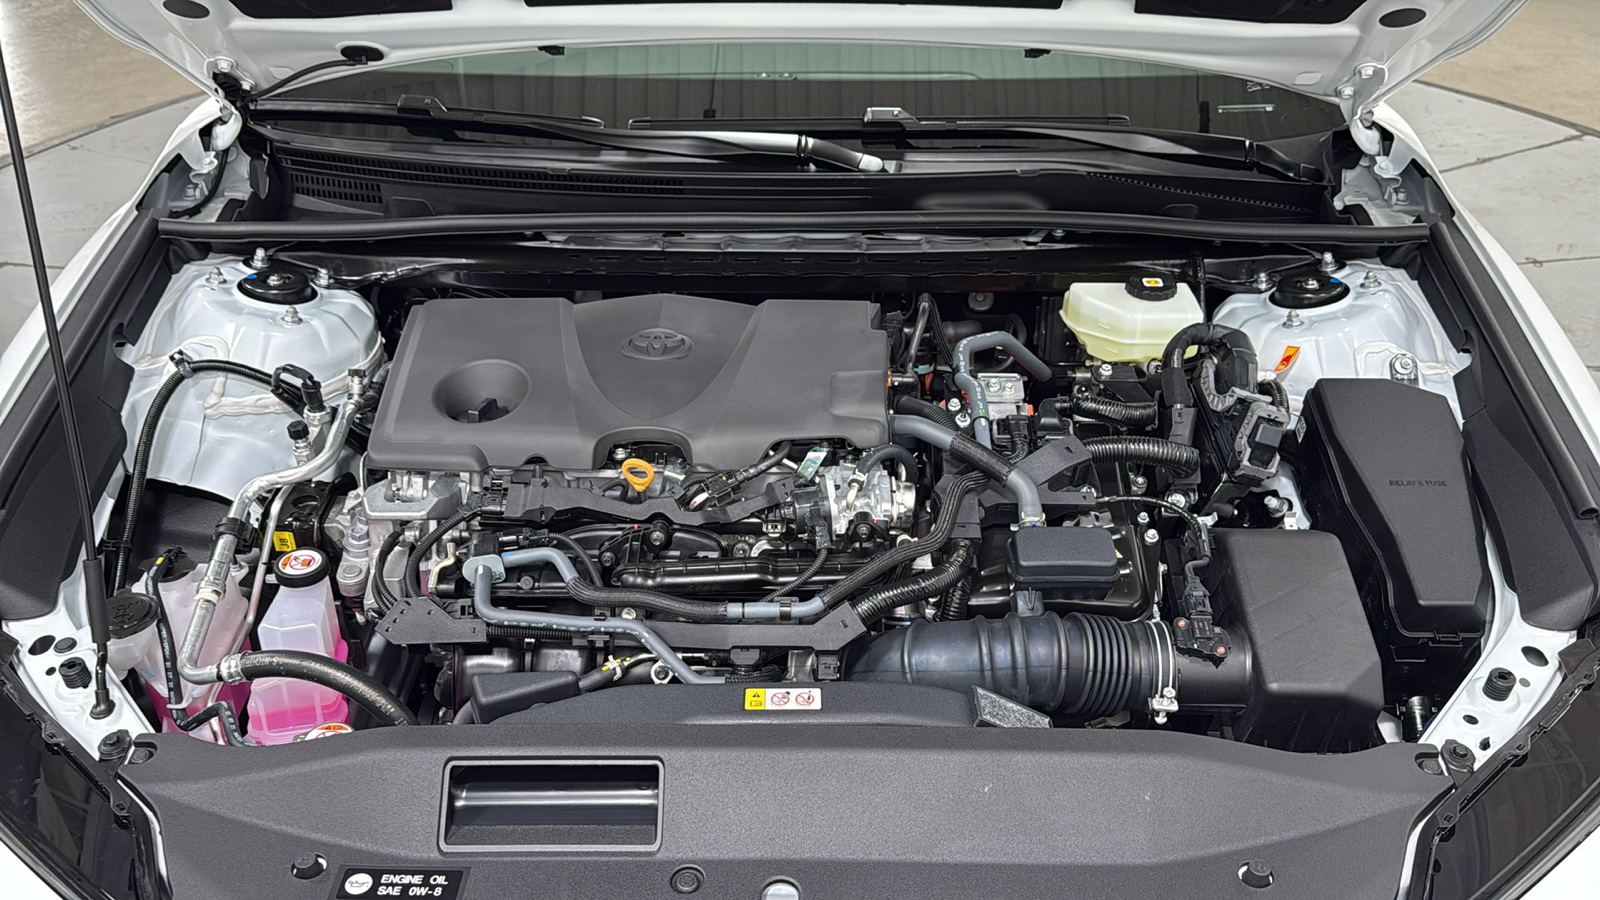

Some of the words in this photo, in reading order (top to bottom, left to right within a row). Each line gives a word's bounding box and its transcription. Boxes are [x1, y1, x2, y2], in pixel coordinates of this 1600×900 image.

[279, 537, 290, 549] J8
[380, 874, 424, 884] ENGINE
[429, 875, 449, 885] OIL
[377, 886, 402, 896] SAE
[408, 886, 443, 897] 0W-8
